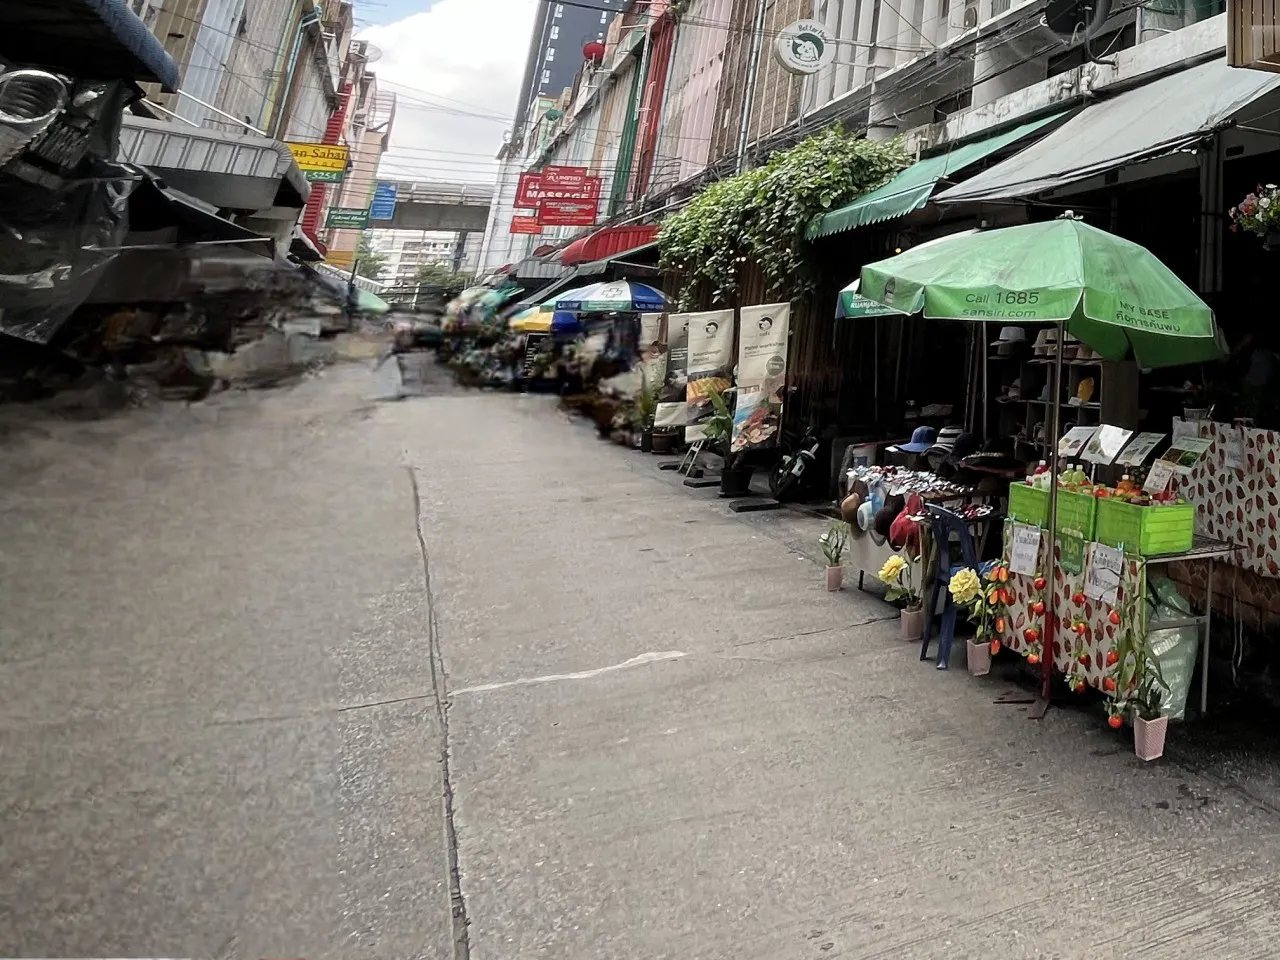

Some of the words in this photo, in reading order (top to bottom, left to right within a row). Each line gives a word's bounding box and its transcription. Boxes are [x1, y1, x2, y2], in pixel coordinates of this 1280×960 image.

[312, 148, 347, 161] Sabai
[965, 293, 990, 304] Call
[996, 291, 1040, 305] 1685
[961, 308, 1037, 318] sansiri.com
[1119, 300, 1136, 313] MY
[1139, 307, 1170, 320] BASE
